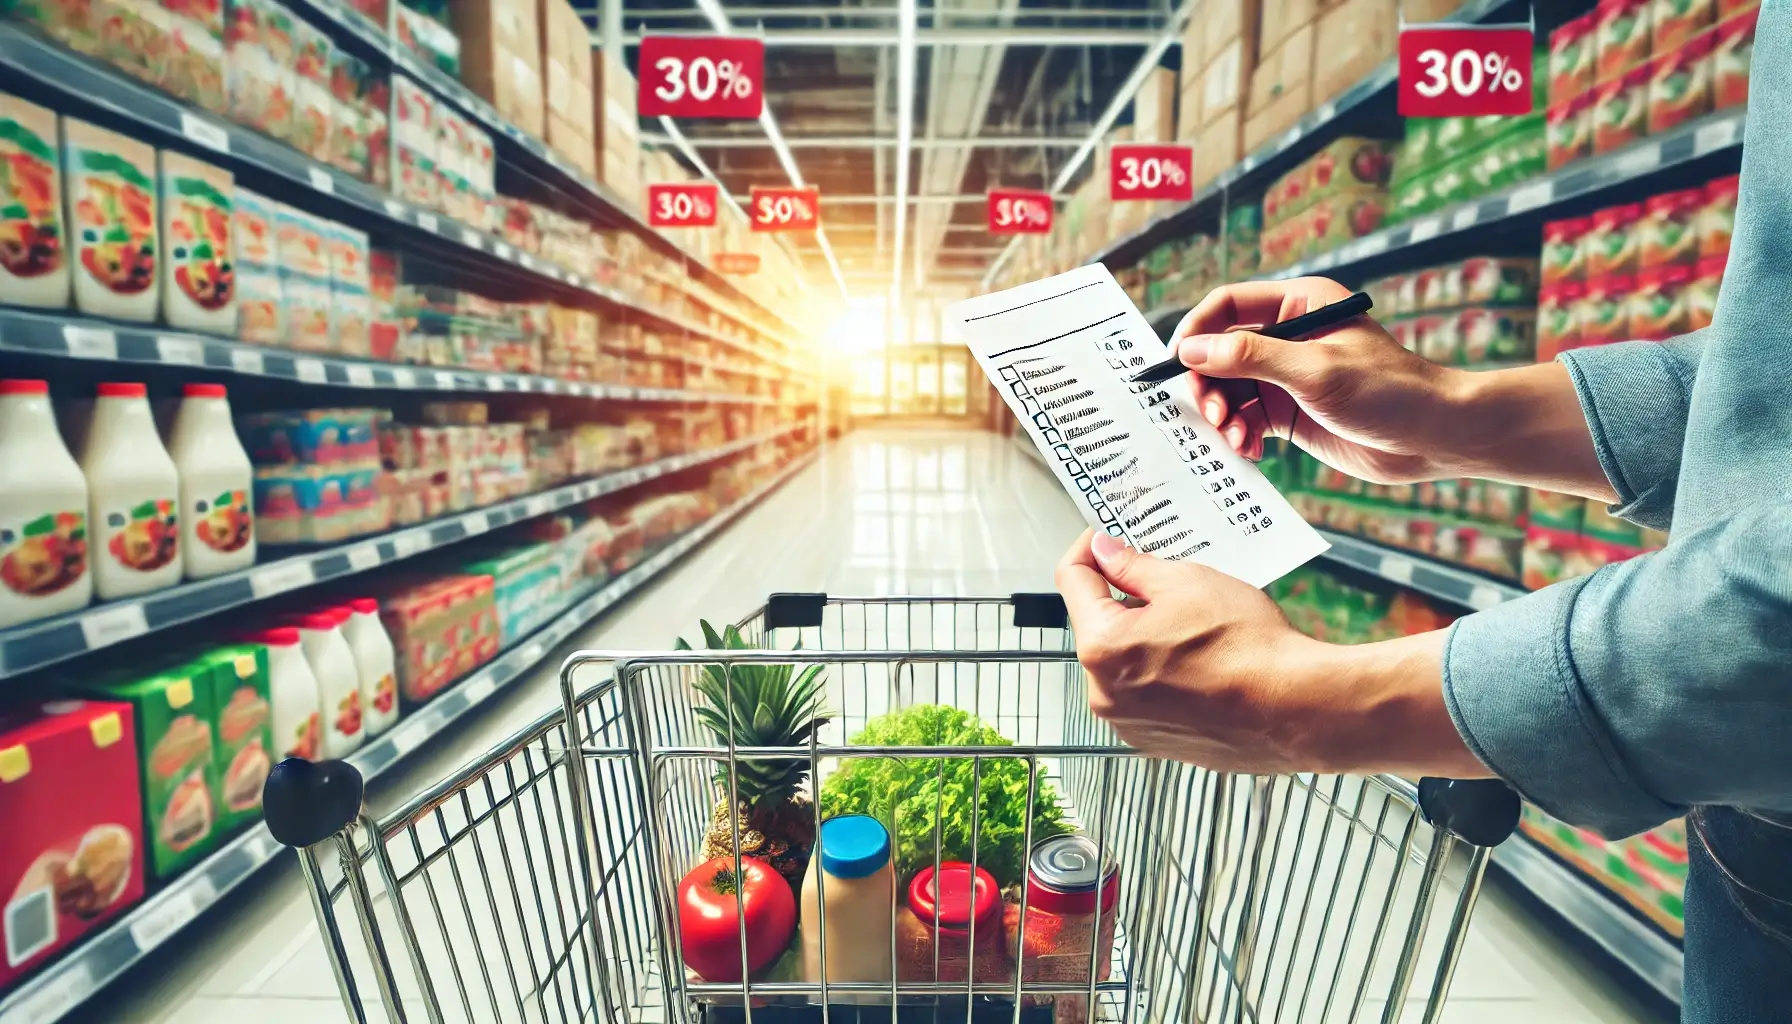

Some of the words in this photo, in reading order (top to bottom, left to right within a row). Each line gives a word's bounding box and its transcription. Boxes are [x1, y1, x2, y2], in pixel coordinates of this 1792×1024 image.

[656, 57, 752, 101] 30%
[1415, 49, 1522, 97] 30%
[1119, 157, 1187, 190] 30%
